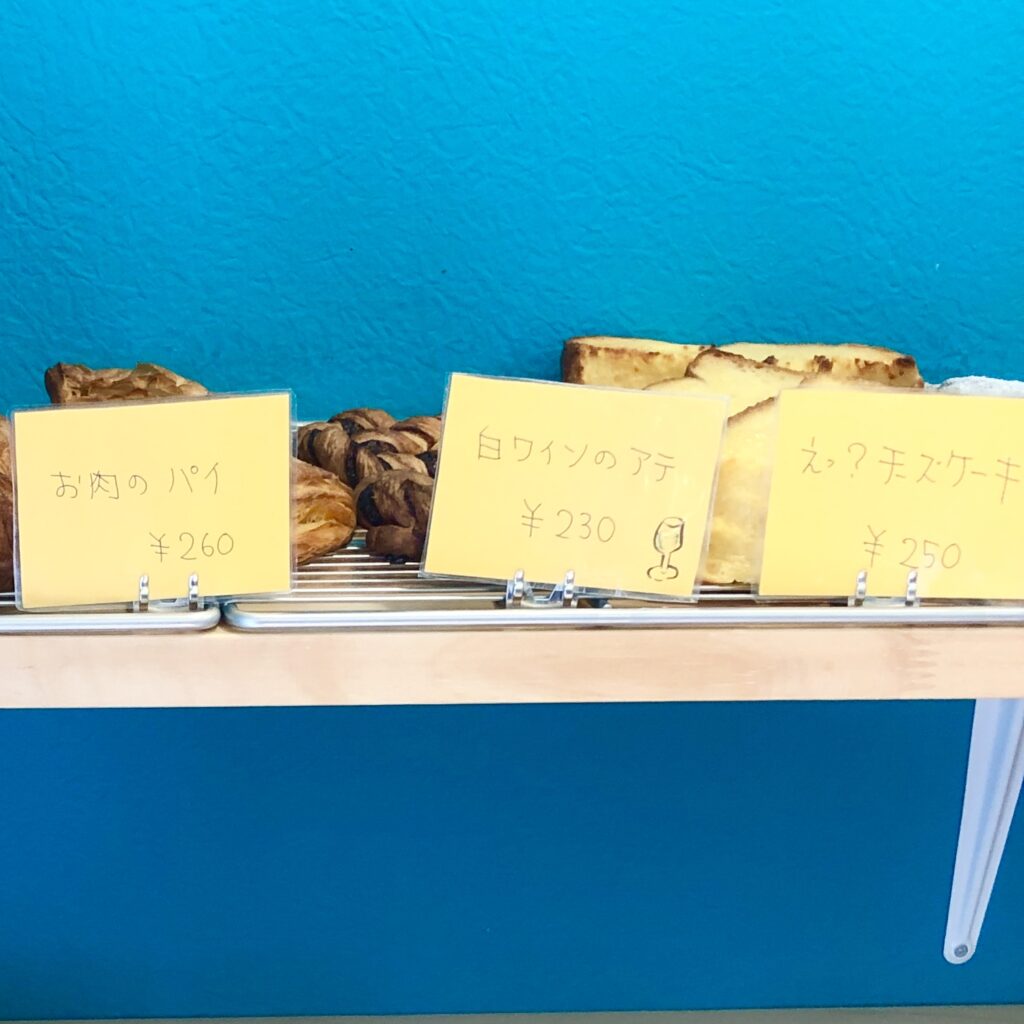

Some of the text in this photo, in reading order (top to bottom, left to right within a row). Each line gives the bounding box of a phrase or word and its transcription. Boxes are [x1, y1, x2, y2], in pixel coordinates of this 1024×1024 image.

[478, 425, 675, 481] 白ワインのアテ
[51, 462, 221, 499] お肉のパイ
